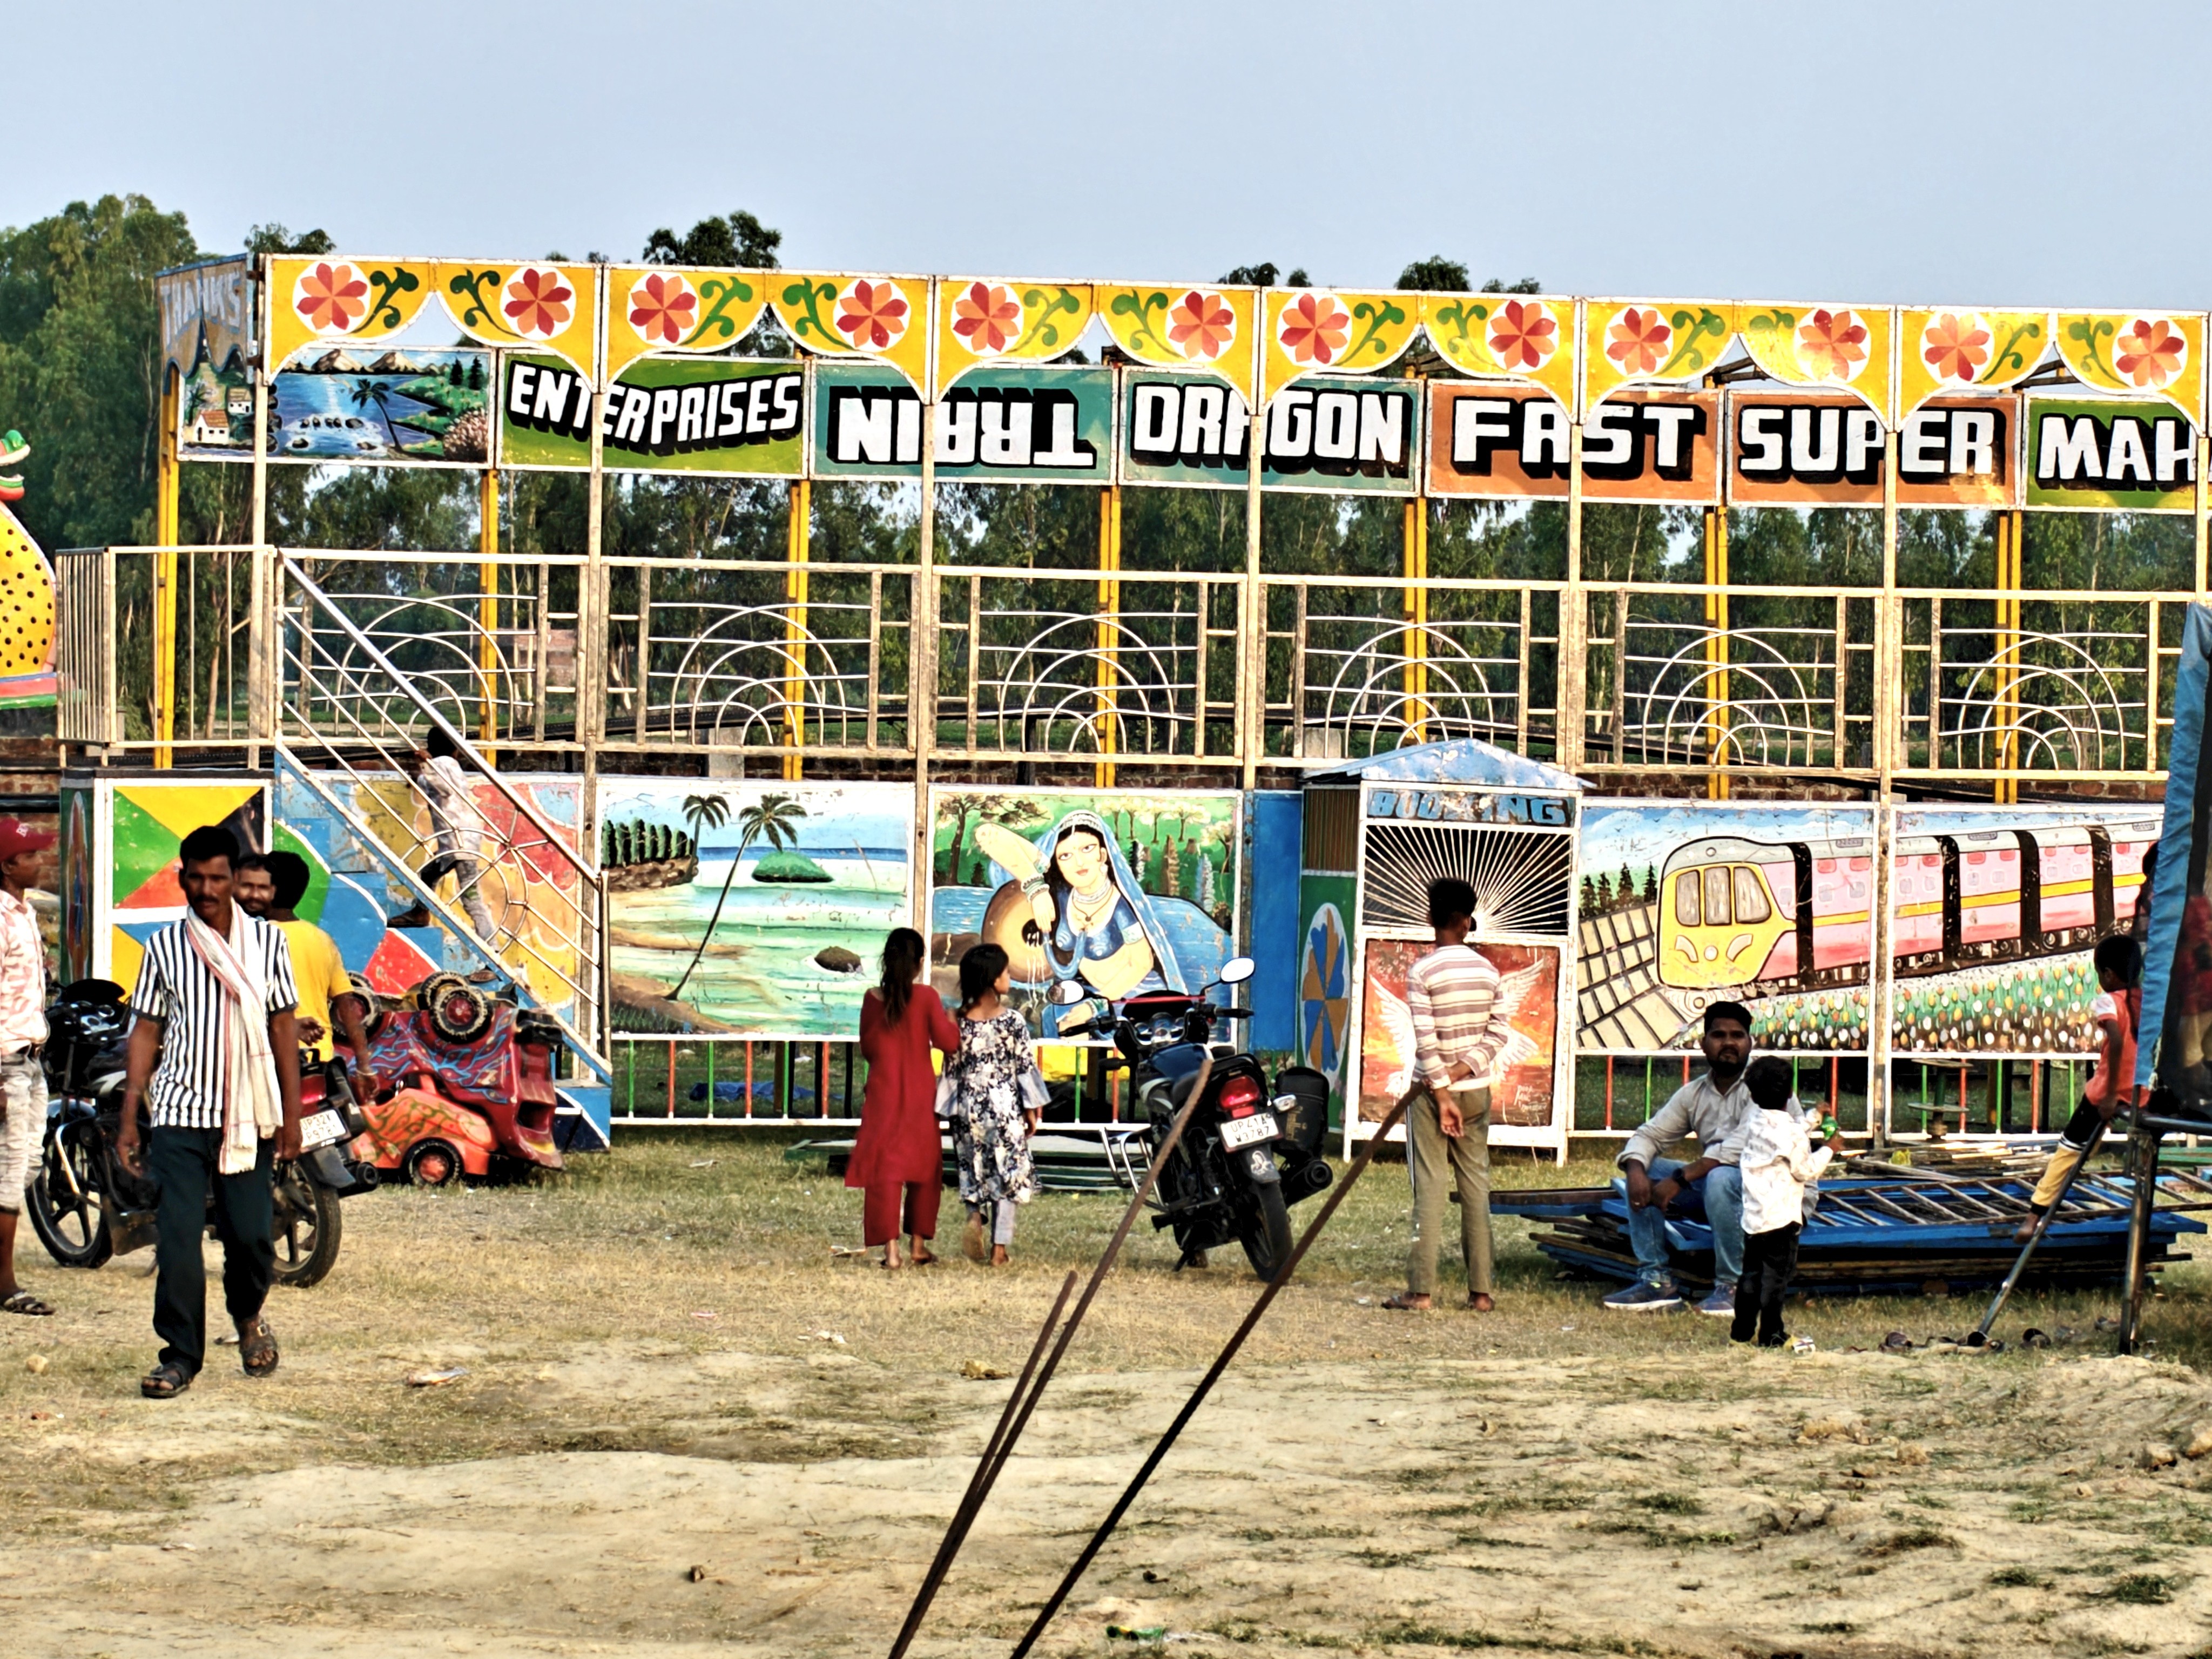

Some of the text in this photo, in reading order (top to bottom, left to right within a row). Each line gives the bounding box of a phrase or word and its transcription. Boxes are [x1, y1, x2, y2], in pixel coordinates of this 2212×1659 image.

[508, 361, 803, 450] ENTERPRISES
[835, 394, 1095, 467] TRAIN
[1132, 384, 1406, 466] DRAGON
[1452, 398, 1697, 470] FAST
[1738, 406, 1998, 477] SUPER
[2037, 415, 2212, 482] MAH
